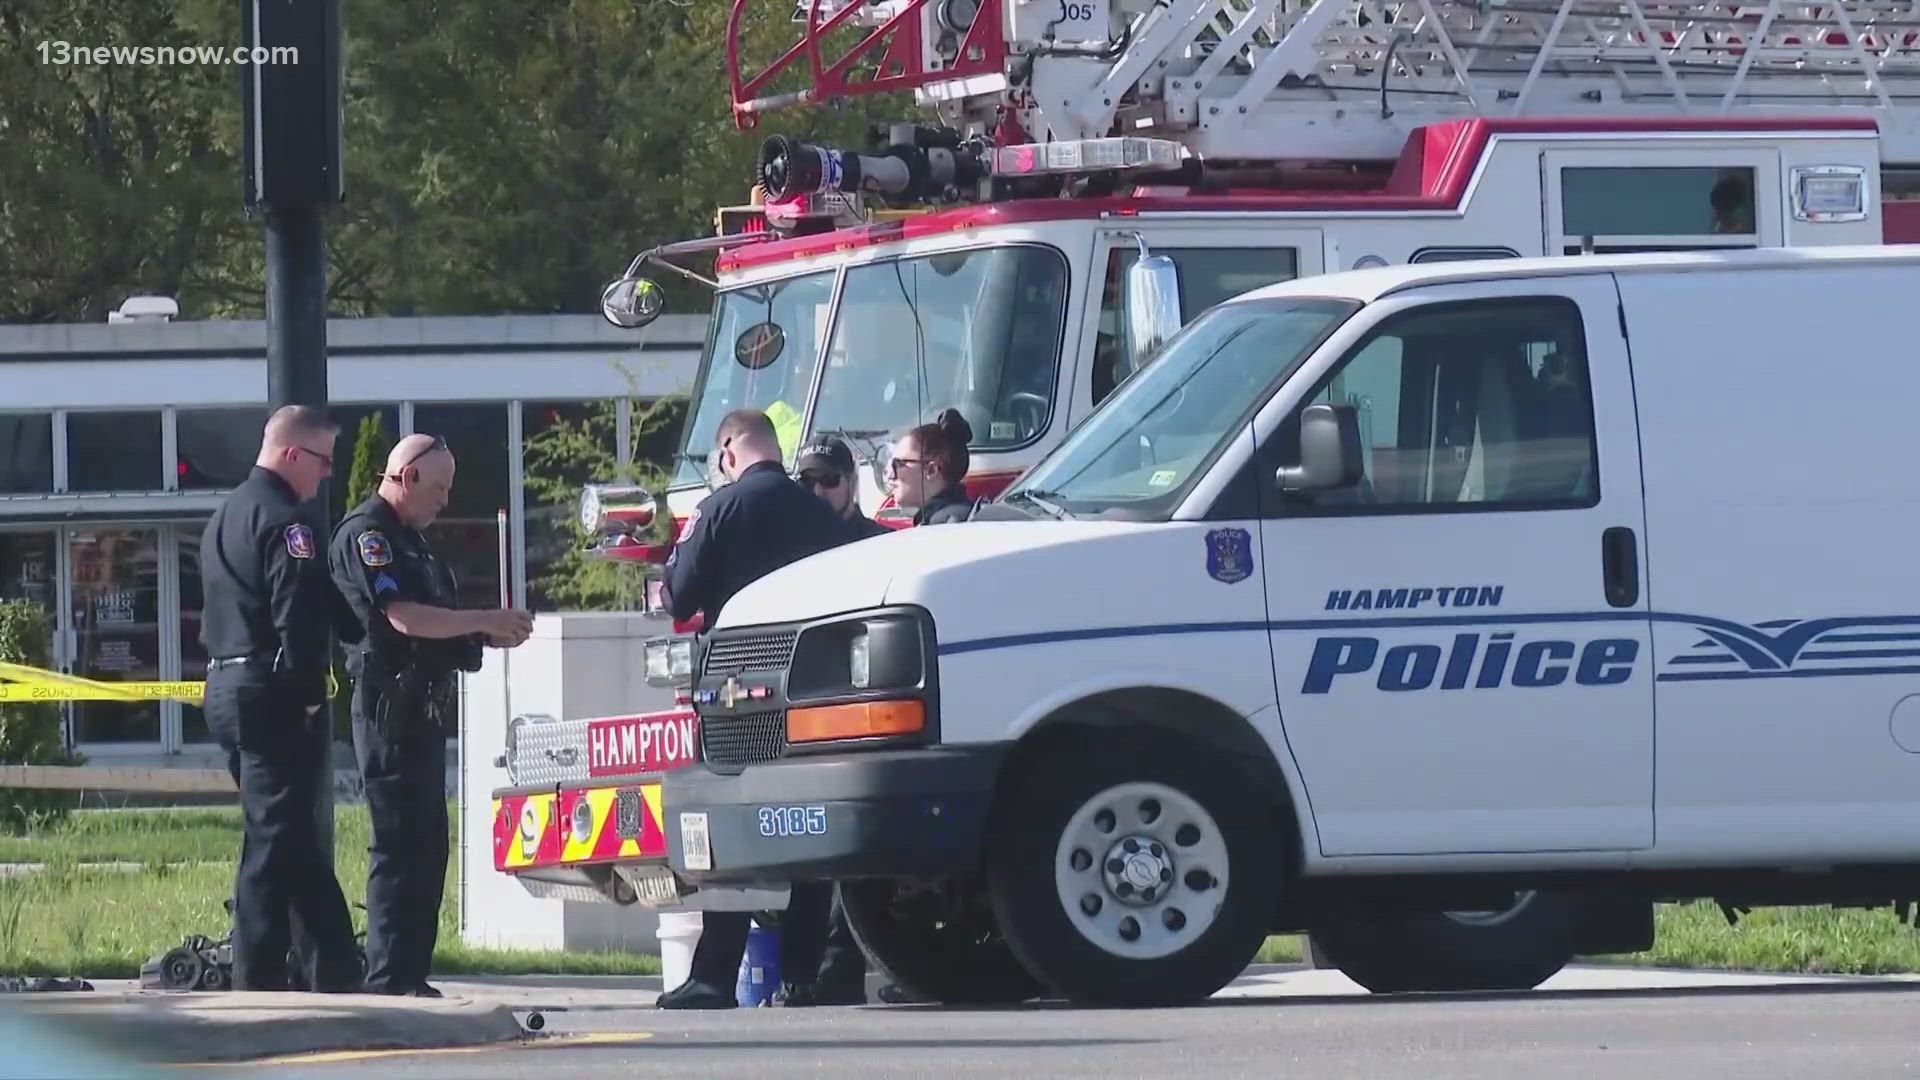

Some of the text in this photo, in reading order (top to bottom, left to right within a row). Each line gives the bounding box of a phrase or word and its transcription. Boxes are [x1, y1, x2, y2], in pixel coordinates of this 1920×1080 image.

[1060, 4, 1096, 20] 05'
[1324, 585, 1504, 611] HAMPTON
[1301, 632, 1640, 694] Police
[591, 719, 694, 768] HAMPTON
[520, 800, 540, 860] 9
[759, 806, 827, 836] 3185
